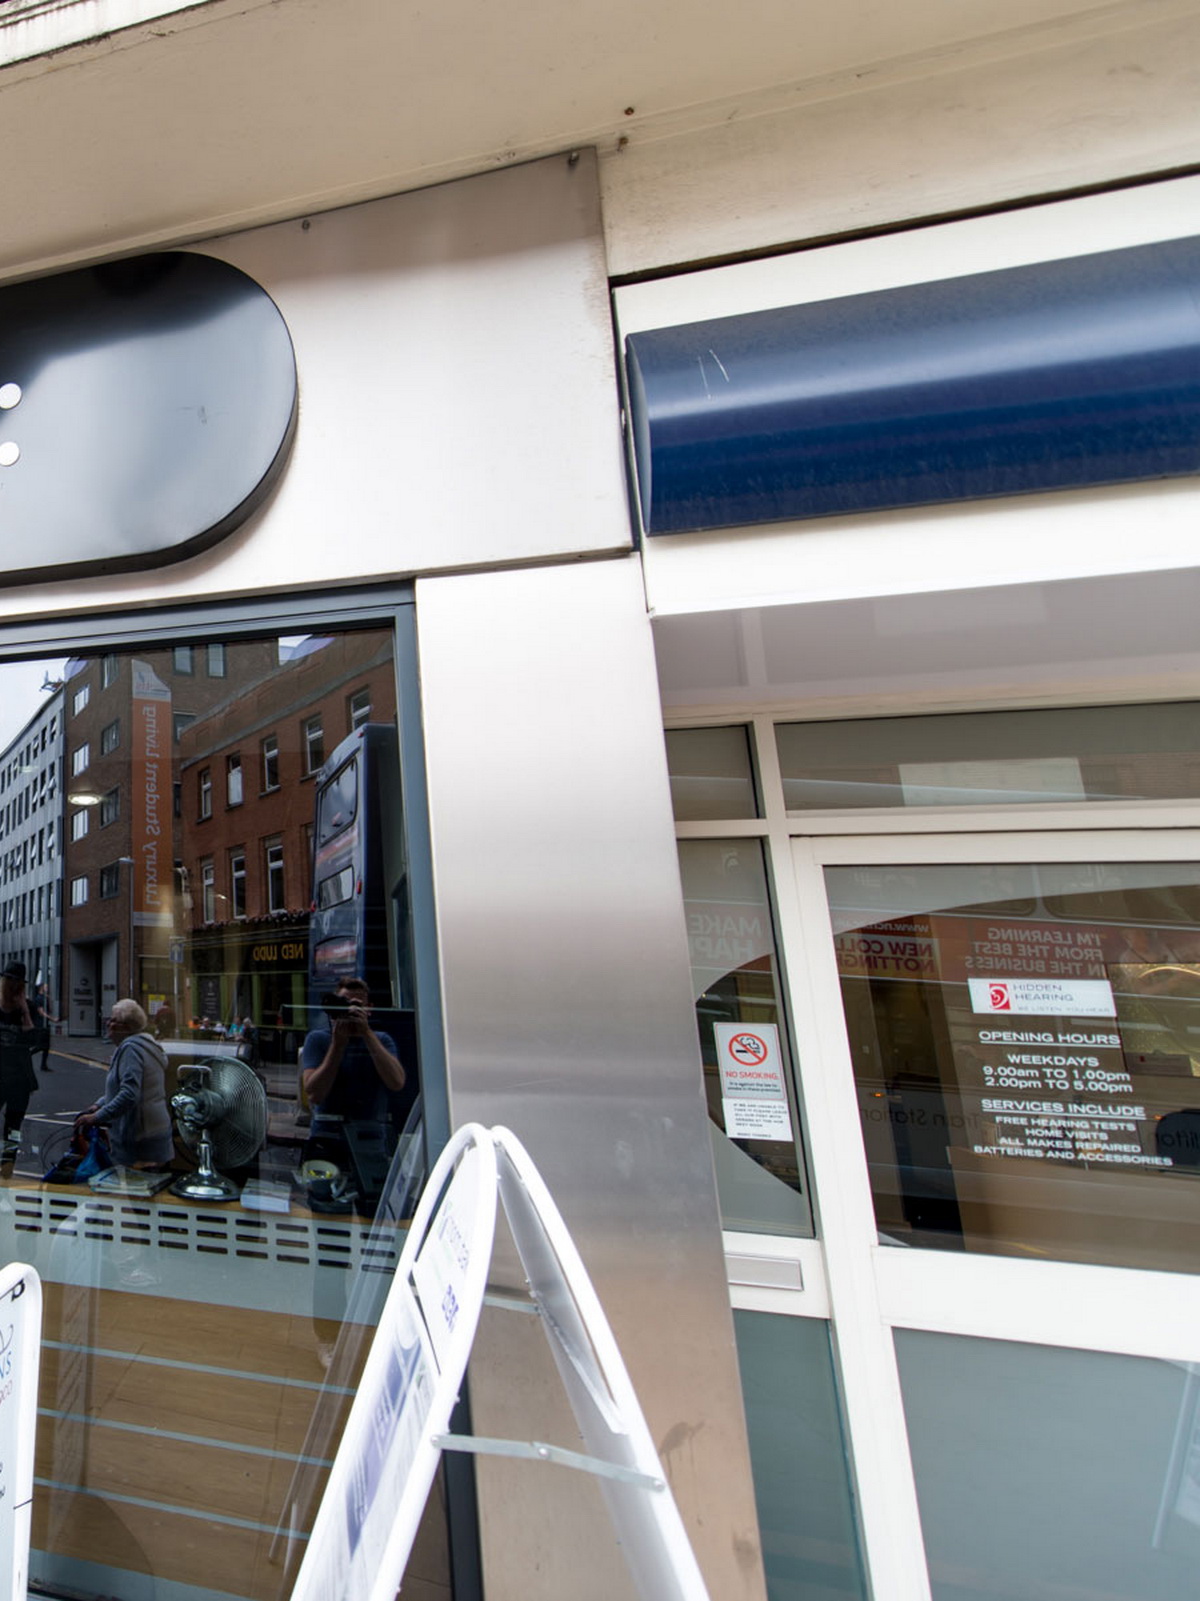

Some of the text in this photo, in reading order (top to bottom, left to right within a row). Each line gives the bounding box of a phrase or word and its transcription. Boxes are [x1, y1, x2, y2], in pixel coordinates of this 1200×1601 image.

[1013, 983, 1062, 992] HIDDEN
[1015, 993, 1074, 1002] HEARING
[978, 1030, 1121, 1045] OPENING HOURS
[1007, 1054, 1100, 1067] WEEKDAYS
[983, 1066, 1131, 1083] 9.00am TO 1.00pm
[985, 1077, 1133, 1093] 2.00pm TO 5.00pm
[981, 1099, 1146, 1117] SERVICES INCLUDE
[995, 1116, 1136, 1132] FREE HEARING TESTS
[1025, 1128, 1109, 1141] HOME VISITS
[999, 1137, 1141, 1153] ALL MAKES REPAIRED
[973, 1145, 1173, 1167] BATTERIES AND ACCESSORIES
